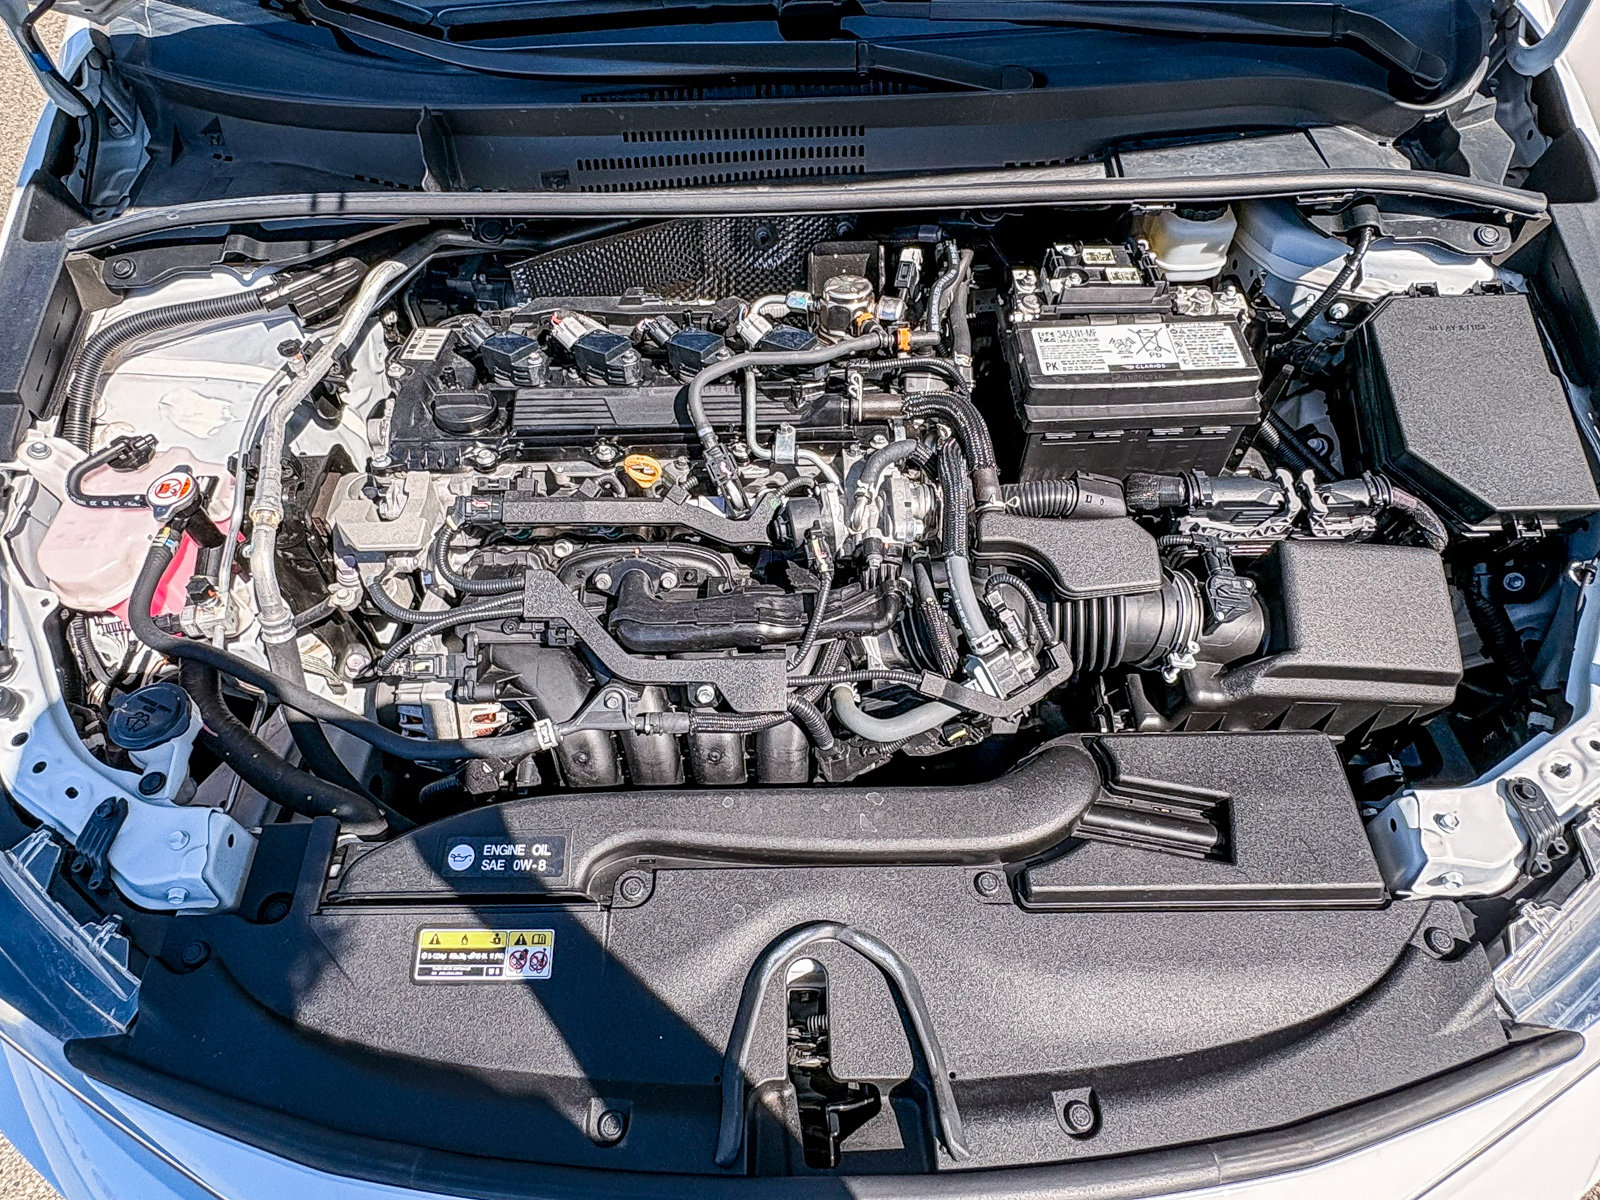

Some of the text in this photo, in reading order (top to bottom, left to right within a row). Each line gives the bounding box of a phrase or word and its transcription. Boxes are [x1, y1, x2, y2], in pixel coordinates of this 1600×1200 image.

[1045, 361, 1059, 371] PK
[483, 843, 551, 856] ENGINE OIL
[481, 859, 546, 871] SAE 0W-8
